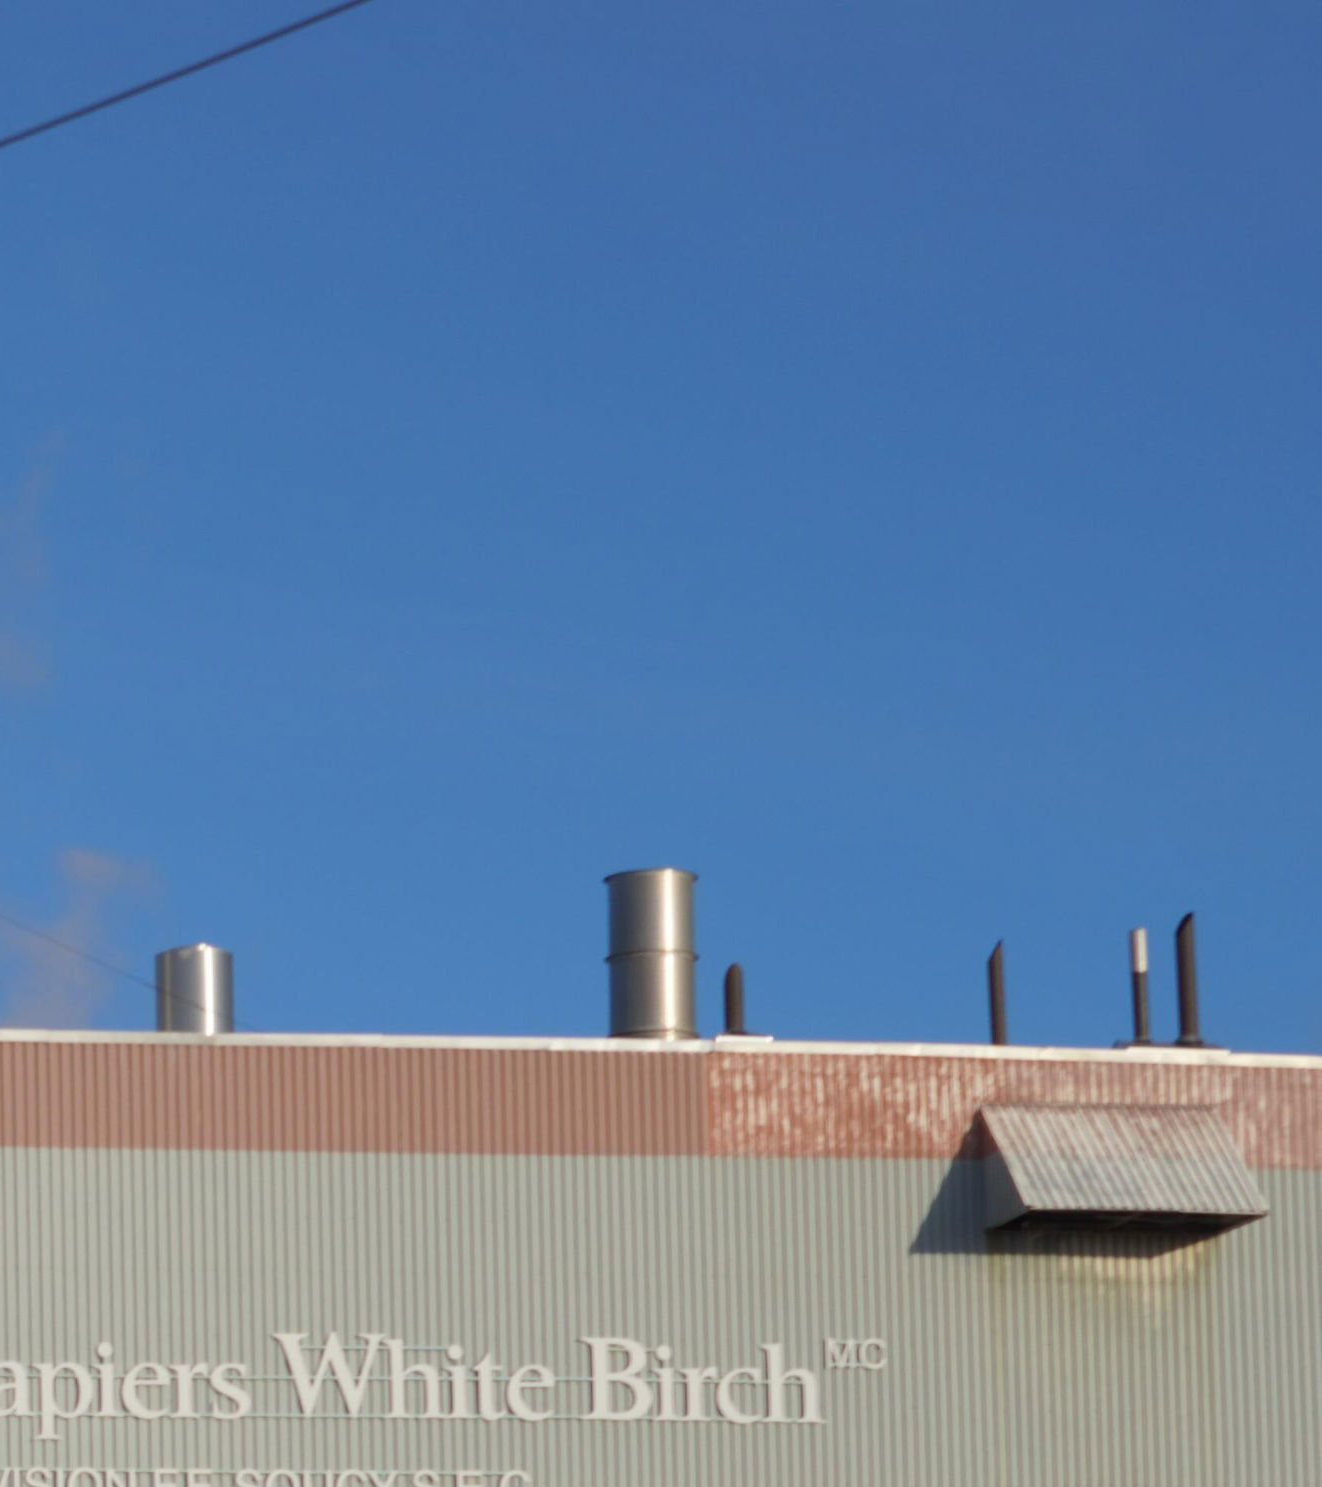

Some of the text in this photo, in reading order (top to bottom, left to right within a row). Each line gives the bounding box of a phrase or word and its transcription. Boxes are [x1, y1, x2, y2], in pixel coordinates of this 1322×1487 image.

[271, 1331, 556, 1421] White
[577, 1336, 829, 1424] Birch
[826, 1338, 889, 1370] MC
